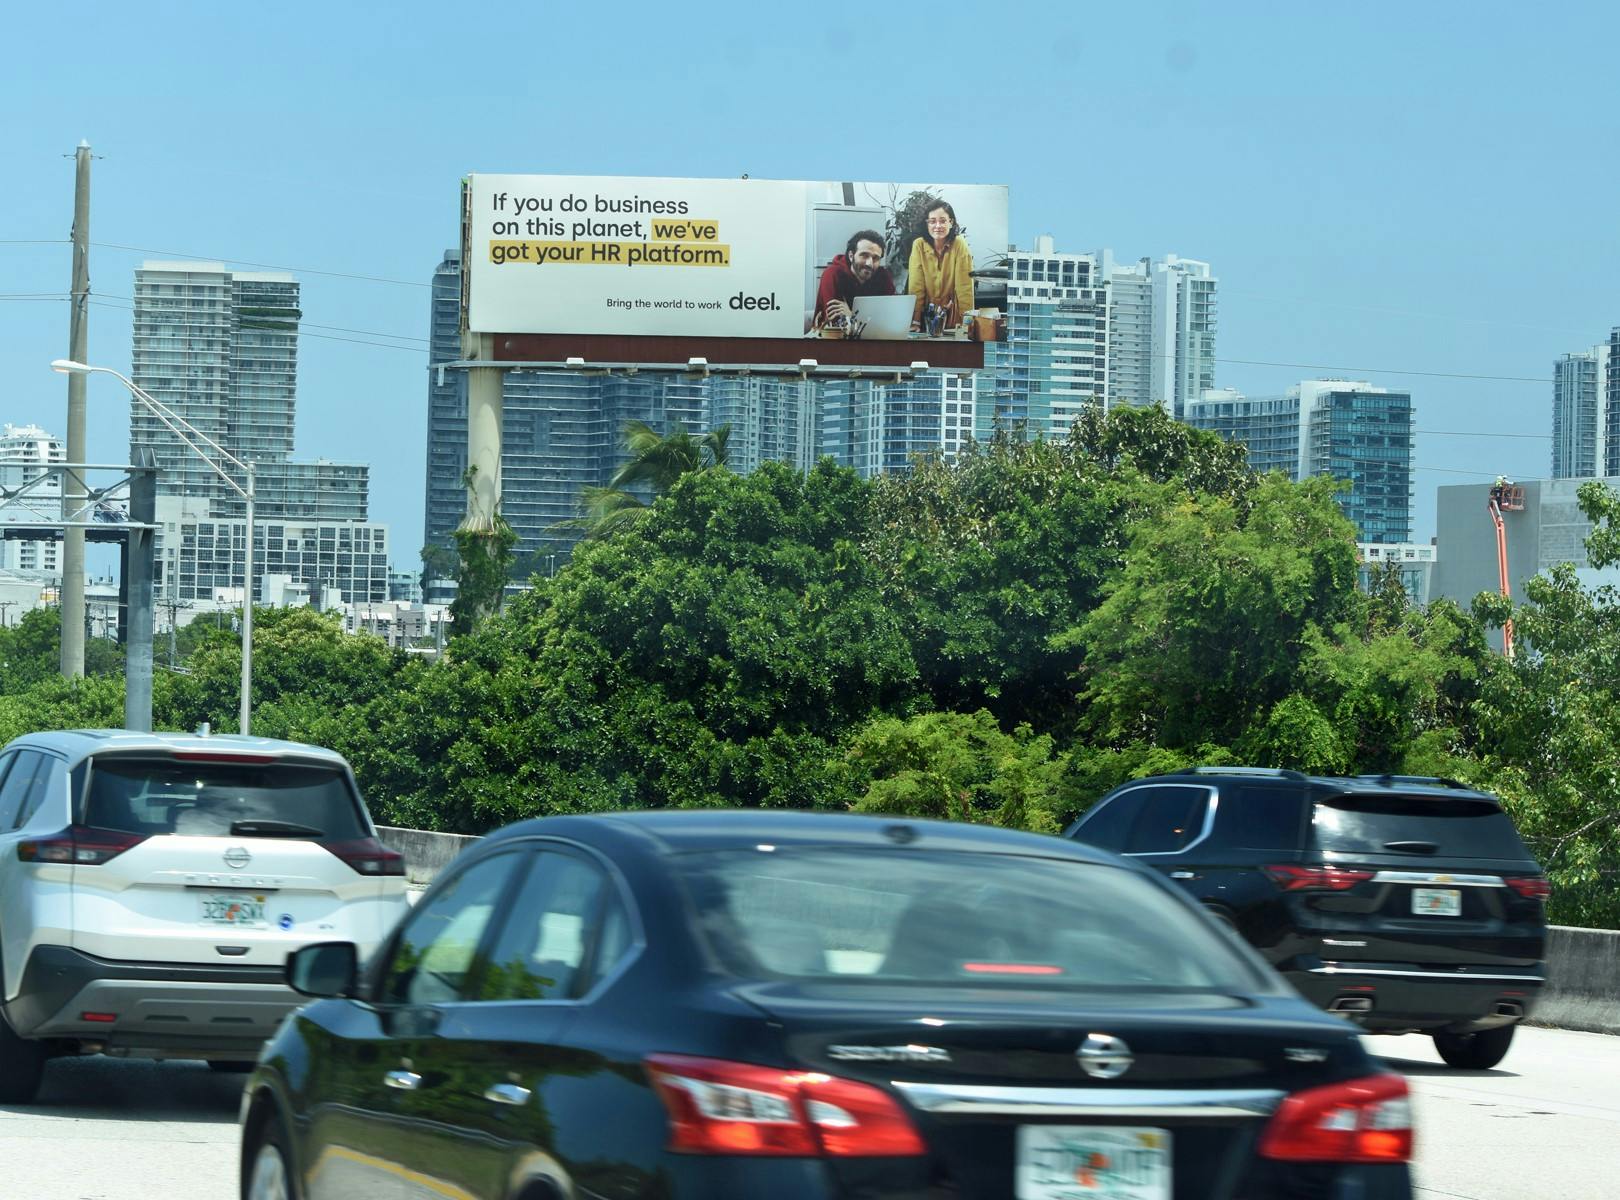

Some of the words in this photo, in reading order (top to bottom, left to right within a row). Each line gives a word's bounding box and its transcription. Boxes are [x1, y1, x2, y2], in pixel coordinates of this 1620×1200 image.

[492, 193, 507, 211] If
[513, 198, 553, 216] you
[559, 193, 588, 212] do
[595, 195, 689, 215] business
[492, 221, 519, 235] on
[526, 217, 565, 236] this
[572, 218, 648, 242] planet,
[654, 221, 716, 240] we've
[491, 243, 530, 265] got
[535, 246, 585, 266] your
[591, 243, 621, 262] HR
[628, 244, 729, 267] platform.
[606, 298, 632, 310] Bring
[635, 299, 652, 308] the
[653, 299, 682, 309] world
[685, 300, 695, 309] to
[697, 300, 722, 310] work
[728, 291, 781, 311] deel.
